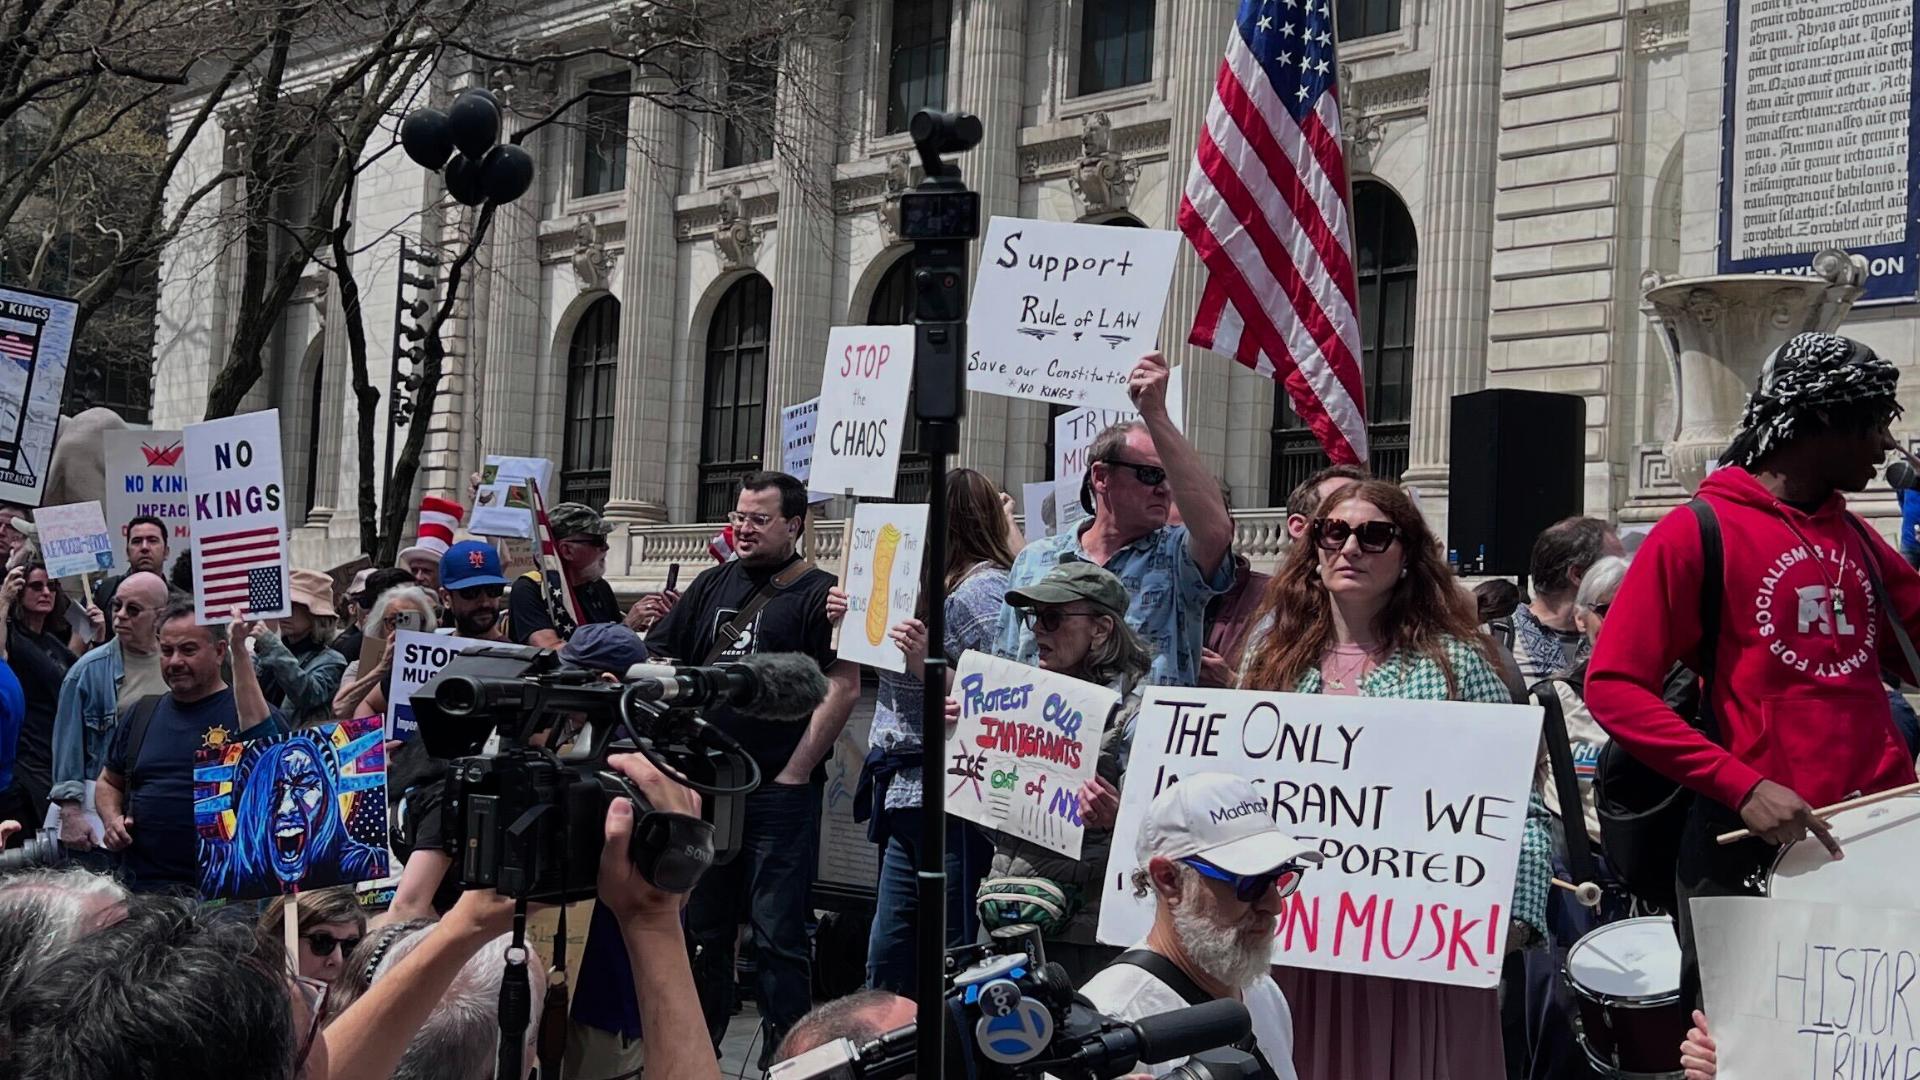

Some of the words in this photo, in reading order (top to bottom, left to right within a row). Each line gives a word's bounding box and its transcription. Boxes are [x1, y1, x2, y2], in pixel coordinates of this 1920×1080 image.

[996, 230, 1133, 282] Support
[9, 303, 48, 320] KINGS
[1019, 295, 1067, 326] Rule
[1074, 310, 1094, 327] of
[1098, 308, 1141, 329] LAW
[841, 344, 890, 379] STOP
[967, 351, 1006, 374] Save
[1015, 365, 1037, 377] our
[1047, 359, 1131, 384] Constitutio
[1017, 382, 1033, 394] NO
[1040, 385, 1074, 399] KINGS
[830, 419, 887, 457] CHAOS
[215, 440, 252, 471] NO
[125, 475, 144, 493] NO
[137, 504, 189, 518] IMPEAC
[195, 484, 280, 521] KINGS
[1756, 546, 1808, 637] SOCIALISM
[1769, 639, 1809, 672] FOR
[1814, 649, 1869, 677] PARTY
[1042, 693, 1083, 741] OUR
[1153, 700, 1227, 757] THE
[1242, 700, 1365, 770] ONLY
[1025, 775, 1046, 805] of
[1425, 788, 1516, 842] WE
[1332, 890, 1501, 976] MUSK!
[1775, 941, 1920, 1041] HISTOR
